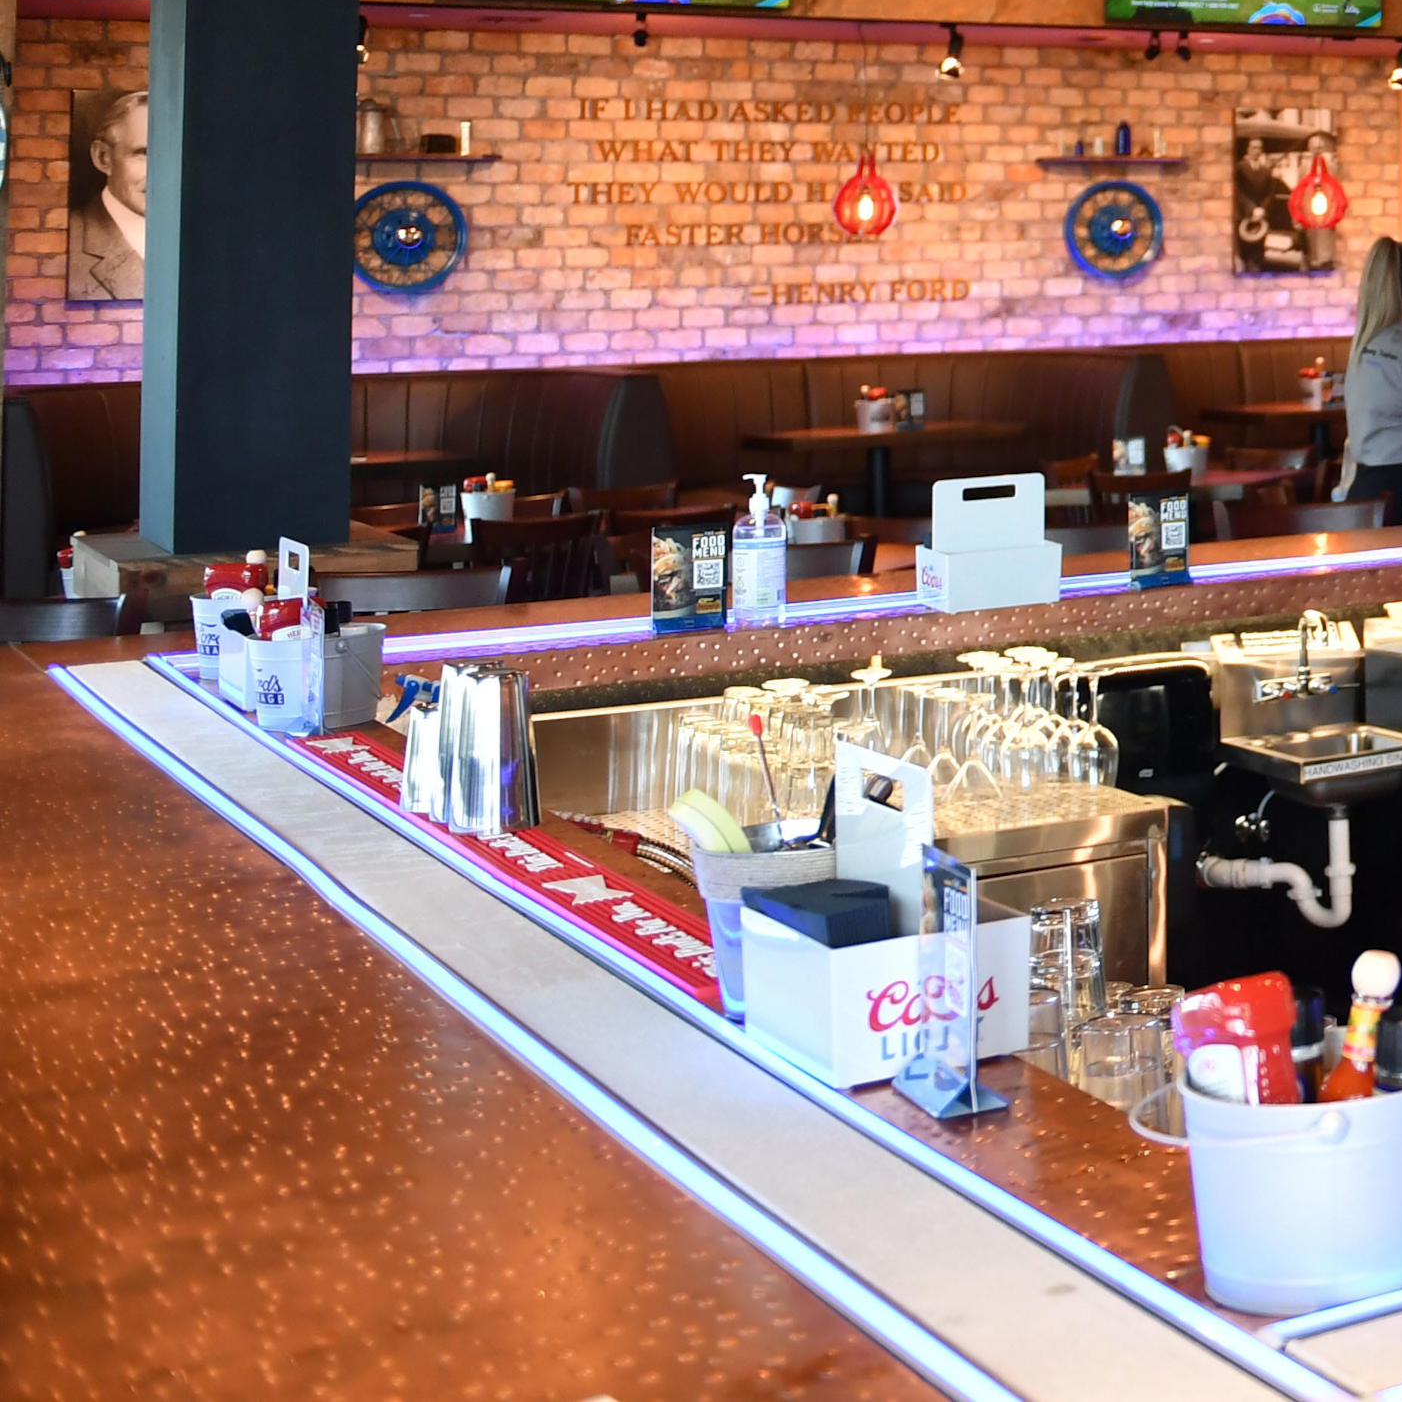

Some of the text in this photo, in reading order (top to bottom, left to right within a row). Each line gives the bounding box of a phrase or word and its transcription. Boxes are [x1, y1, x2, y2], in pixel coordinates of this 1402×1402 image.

[578, 98, 963, 125] IF I HAD ASKED PEOPLE
[598, 140, 941, 163] WHAT THEY WANTED
[567, 182, 666, 204] THEY
[674, 183, 793, 204] WOULD
[899, 183, 968, 203] SAID
[625, 224, 744, 246] FASTER
[890, 279, 971, 303] FORD
[1160, 498, 1188, 513] FOOD
[692, 534, 726, 549] FOOD
[692, 545, 726, 559] MENU
[1304, 755, 1384, 777] HANDWASHING
[866, 975, 1000, 1033] Coos
